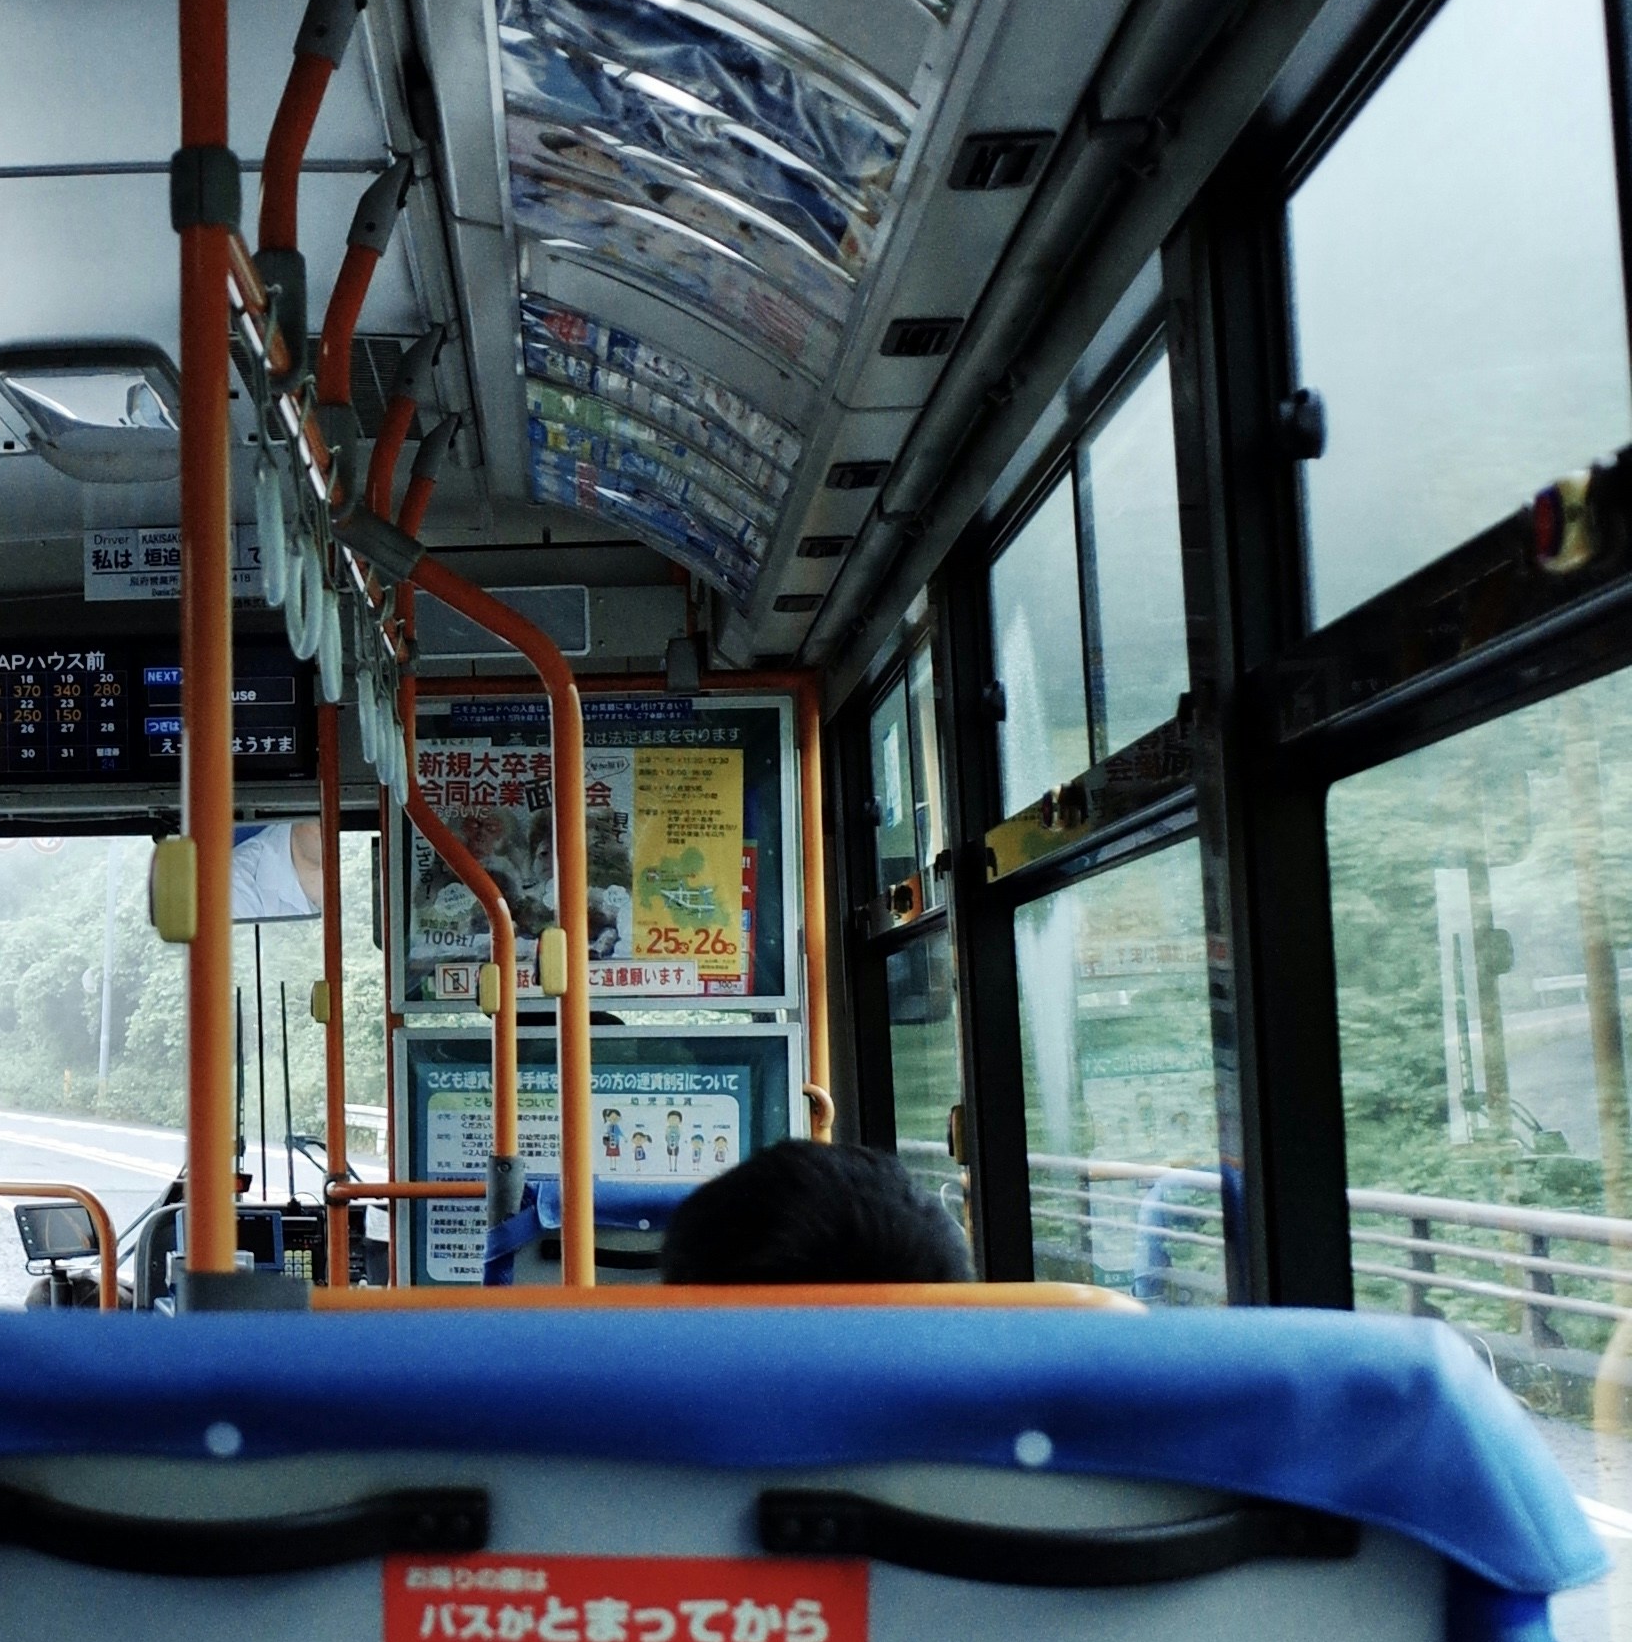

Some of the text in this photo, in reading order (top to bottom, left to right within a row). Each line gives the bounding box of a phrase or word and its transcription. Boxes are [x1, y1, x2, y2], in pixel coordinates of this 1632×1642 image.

[94, 534, 130, 545] Driver
[92, 549, 133, 570] 私は
[21, 675, 34, 684] 18
[61, 674, 74, 683] 19
[100, 673, 114, 683] 20
[147, 671, 179, 682] NEXT
[13, 685, 41, 698] 370
[53, 684, 81, 697] 340
[93, 683, 121, 697] 280
[20, 699, 34, 709] 22
[60, 699, 74, 708] 23
[100, 698, 114, 707] 24
[14, 710, 42, 723] 250
[56, 709, 82, 722] 150
[21, 724, 35, 733] 26
[61, 723, 74, 733] 27
[100, 723, 115, 732] 28
[148, 721, 180, 731] つぎは
[21, 749, 35, 758] 30
[61, 748, 74, 757] 31
[418, 751, 552, 779] 新規大卒者
[420, 779, 612, 813] 合同企業面会
